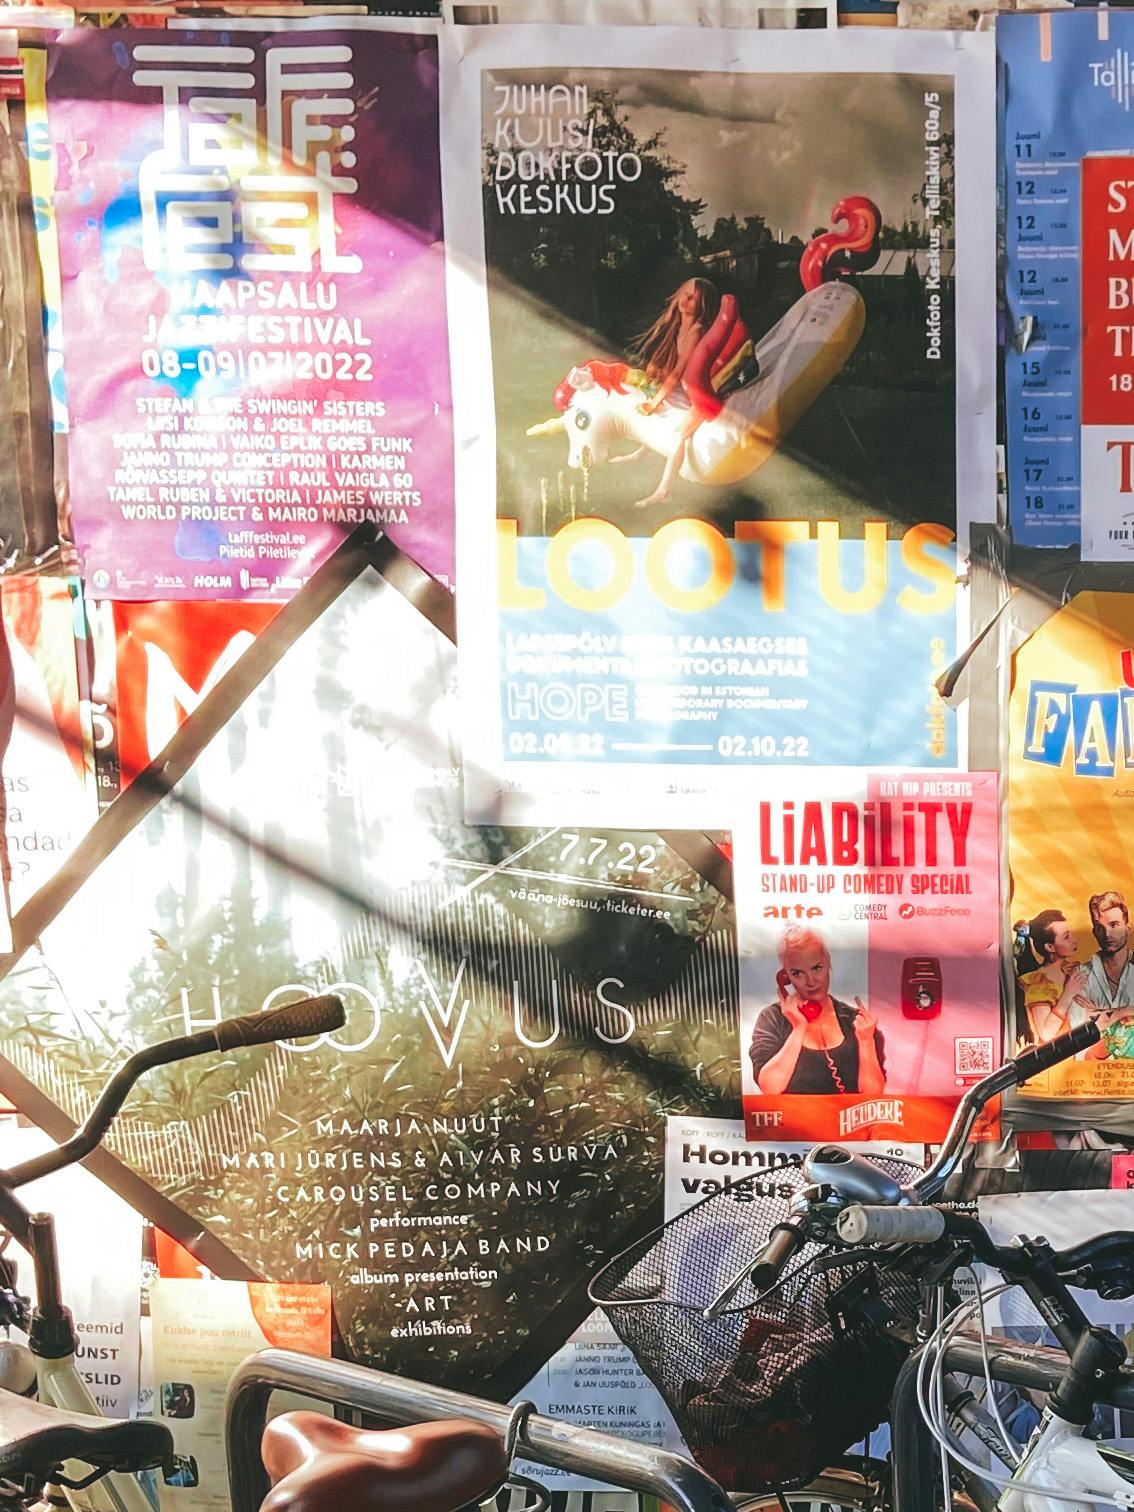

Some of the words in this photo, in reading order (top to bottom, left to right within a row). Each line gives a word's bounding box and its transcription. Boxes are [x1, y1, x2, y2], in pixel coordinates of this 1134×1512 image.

[494, 84, 588, 115] JUHAN
[495, 151, 642, 182] DOKFOTO
[1015, 181, 1036, 195] 12
[495, 184, 617, 214] KESKUS
[926, 293, 942, 360] Dokfoto
[1021, 362, 1041, 376] 15
[324, 400, 385, 417] SISTERS
[372, 437, 412, 453] FUNK
[316, 489, 366, 505] JAMES
[370, 490, 422, 506] WERTS
[181, 506, 246, 521] PROJECT
[268, 507, 318, 522] MAIRO
[495, 517, 958, 614] LOOTUS
[507, 681, 629, 723] HOPE
[717, 735, 809, 757] 02.10.22
[556, 833, 659, 876] 7.7.22
[761, 873, 835, 893] STAND-UP
[843, 873, 904, 895] COMEDY
[763, 903, 823, 919] arte
[854, 911, 888, 921] CENTRAL
[316, 1116, 420, 1135] MAARJA
[432, 1115, 503, 1134] NUUT
[221, 1152, 286, 1169] MARI
[296, 1150, 403, 1169] JÜRJENS
[438, 1148, 522, 1168] AIVAR
[531, 1144, 619, 1164] SURVA
[275, 1183, 415, 1202] CAROUSEL
[425, 1179, 561, 1201] COMPANY
[368, 1212, 469, 1232] performance
[294, 1241, 360, 1260] MICK
[368, 1238, 469, 1259] PEDAJA
[478, 1235, 552, 1256] BAND
[349, 1267, 400, 1286] album
[403, 1266, 499, 1288] presentation
[405, 1295, 453, 1313] ART
[390, 1320, 474, 1339] exhibitions
[547, 1403, 606, 1417] EMMASTE
[607, 1404, 639, 1417] KIRIK
